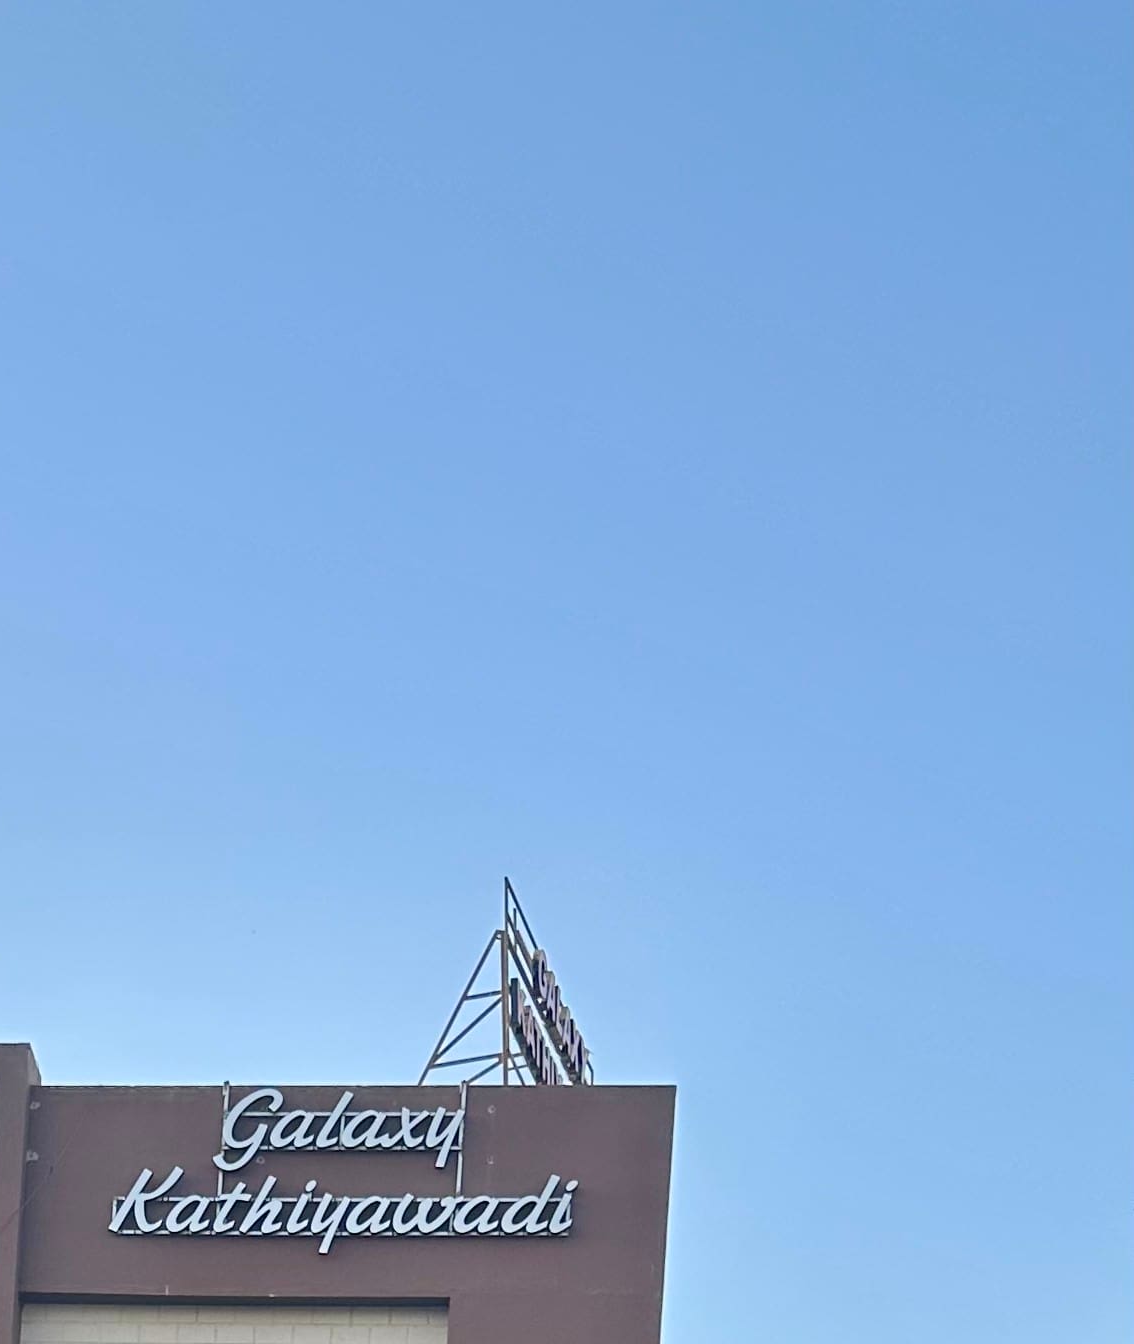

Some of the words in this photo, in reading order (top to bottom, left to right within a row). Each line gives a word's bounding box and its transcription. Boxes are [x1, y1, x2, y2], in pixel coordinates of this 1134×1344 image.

[511, 977, 563, 1086] KATHI
[532, 949, 589, 1085] GALAXY
[213, 1088, 466, 1171] Galaxy
[108, 1166, 579, 1255] Kathiyawadi
